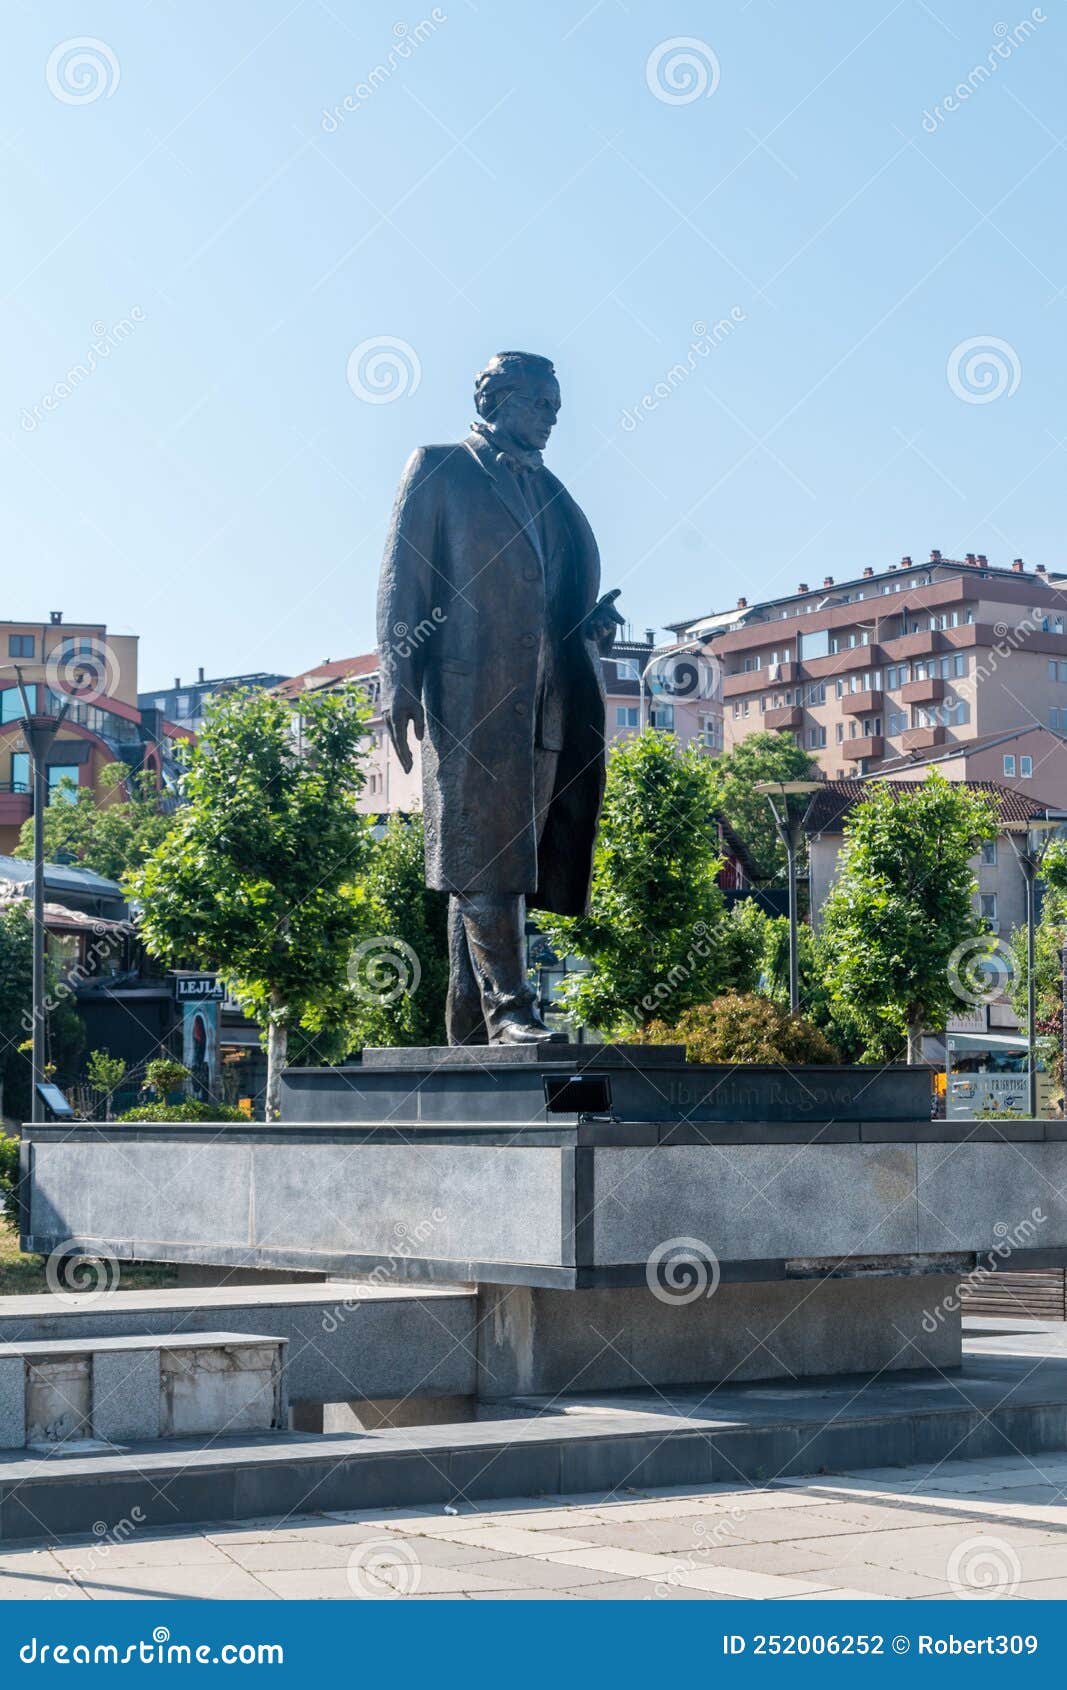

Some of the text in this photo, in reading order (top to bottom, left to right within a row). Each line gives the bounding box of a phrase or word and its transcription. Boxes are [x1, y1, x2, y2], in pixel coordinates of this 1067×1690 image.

[179, 981, 223, 994] LEJLA
[669, 1081, 856, 1111] Ibrahim Rugova
